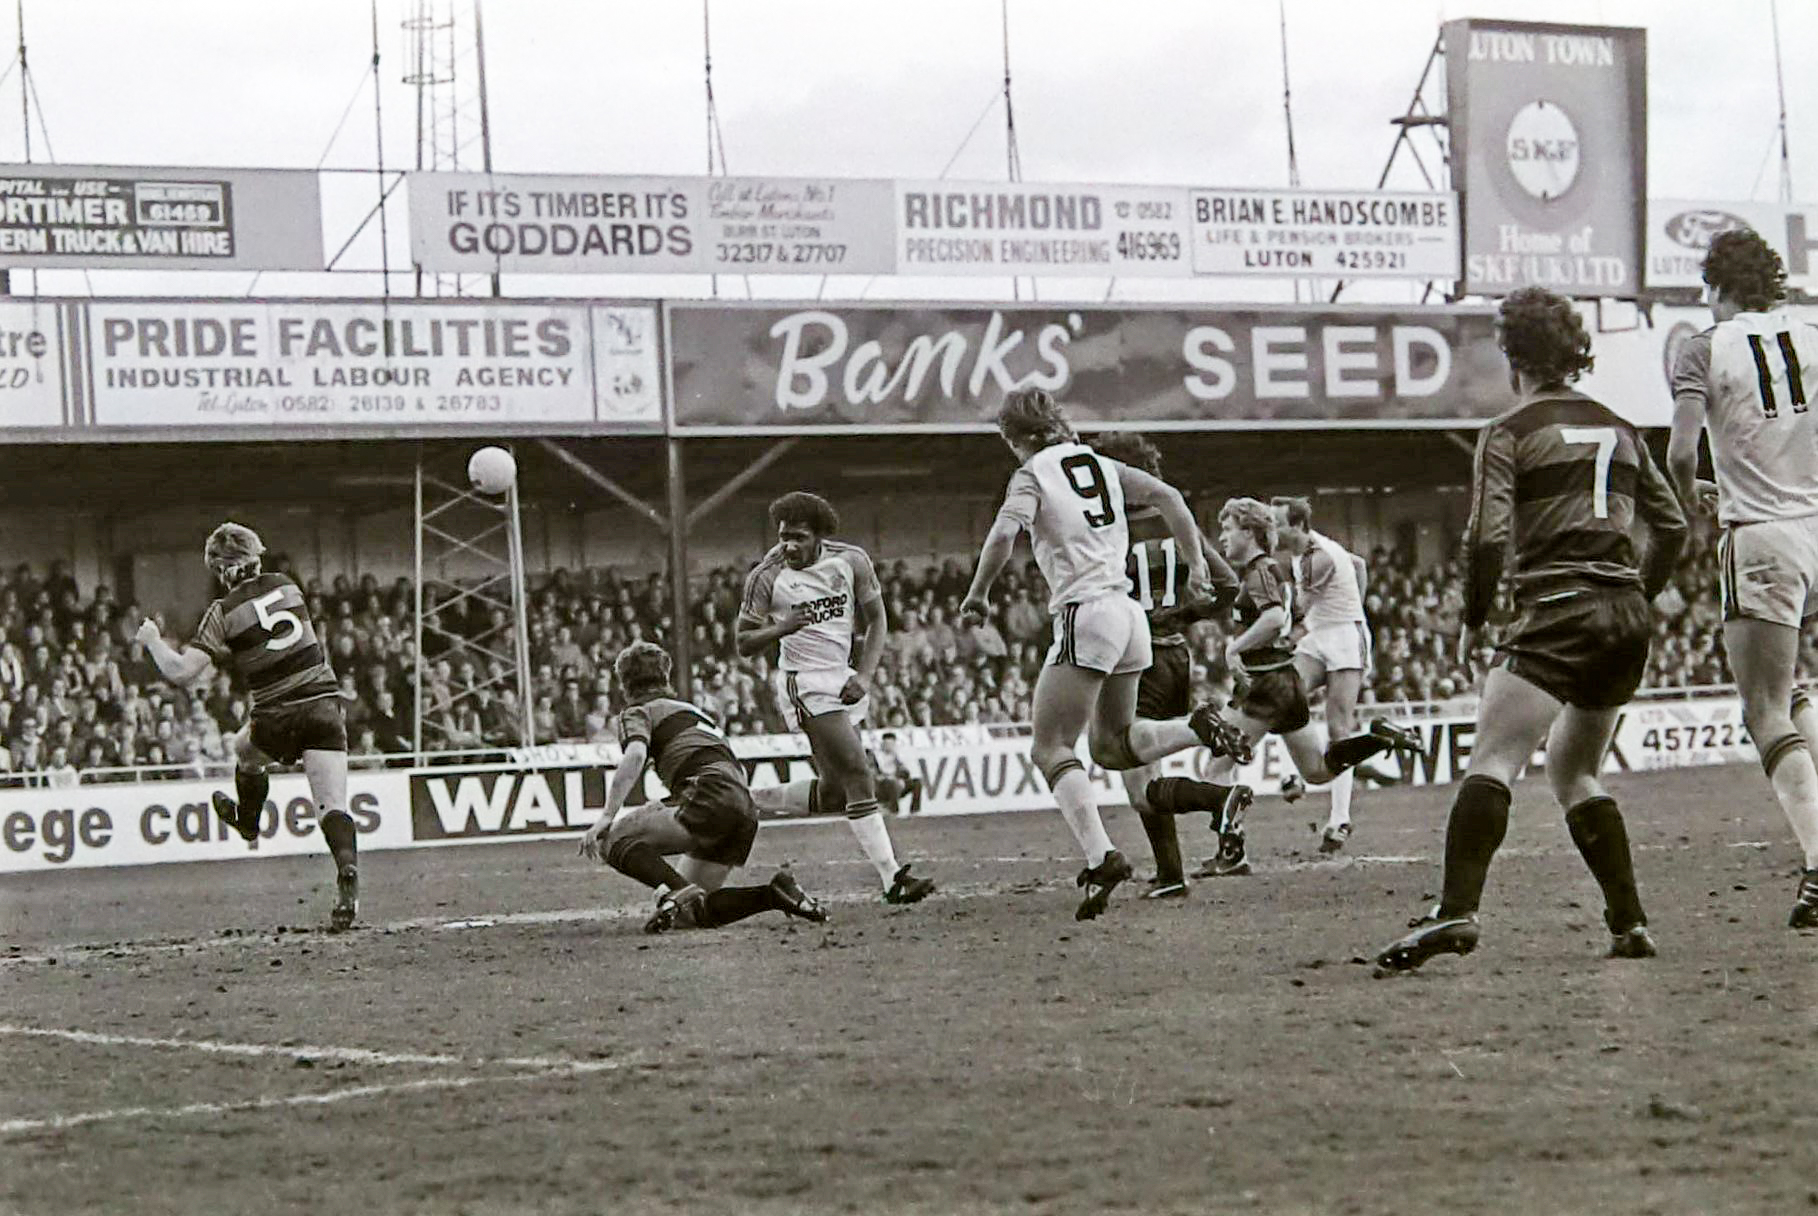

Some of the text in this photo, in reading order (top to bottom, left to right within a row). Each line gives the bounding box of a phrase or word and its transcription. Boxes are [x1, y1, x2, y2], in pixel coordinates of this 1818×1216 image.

[1549, 36, 1615, 66] TOWN
[1512, 139, 1576, 161] SKF
[448, 186, 688, 219] IF IT'S TIMBER IT'S
[904, 193, 1101, 230] RICHMOND
[1196, 198, 1265, 223] BRIAN
[1293, 201, 1448, 227] HANDSCOMBE
[181, 231, 231, 255] HIRE
[449, 222, 693, 256] GODDARDS
[906, 237, 1111, 264] PRECISION ENGINEERING
[1206, 230, 1240, 244] LIFE
[1500, 225, 1593, 255] Home of
[1244, 250, 1406, 269] LUTON 425921
[103, 317, 572, 358] PRIDE FACILITIES
[107, 367, 573, 388] INDUSTRIAL LABOUR AGENCY
[769, 311, 1452, 412] Banks' SEED
[1747, 331, 1809, 418] 11
[1560, 428, 1618, 519] 7
[1061, 453, 1116, 528] 9
[1132, 537, 1177, 611] 11
[252, 590, 303, 651] 5
[3, 807, 113, 863] ege
